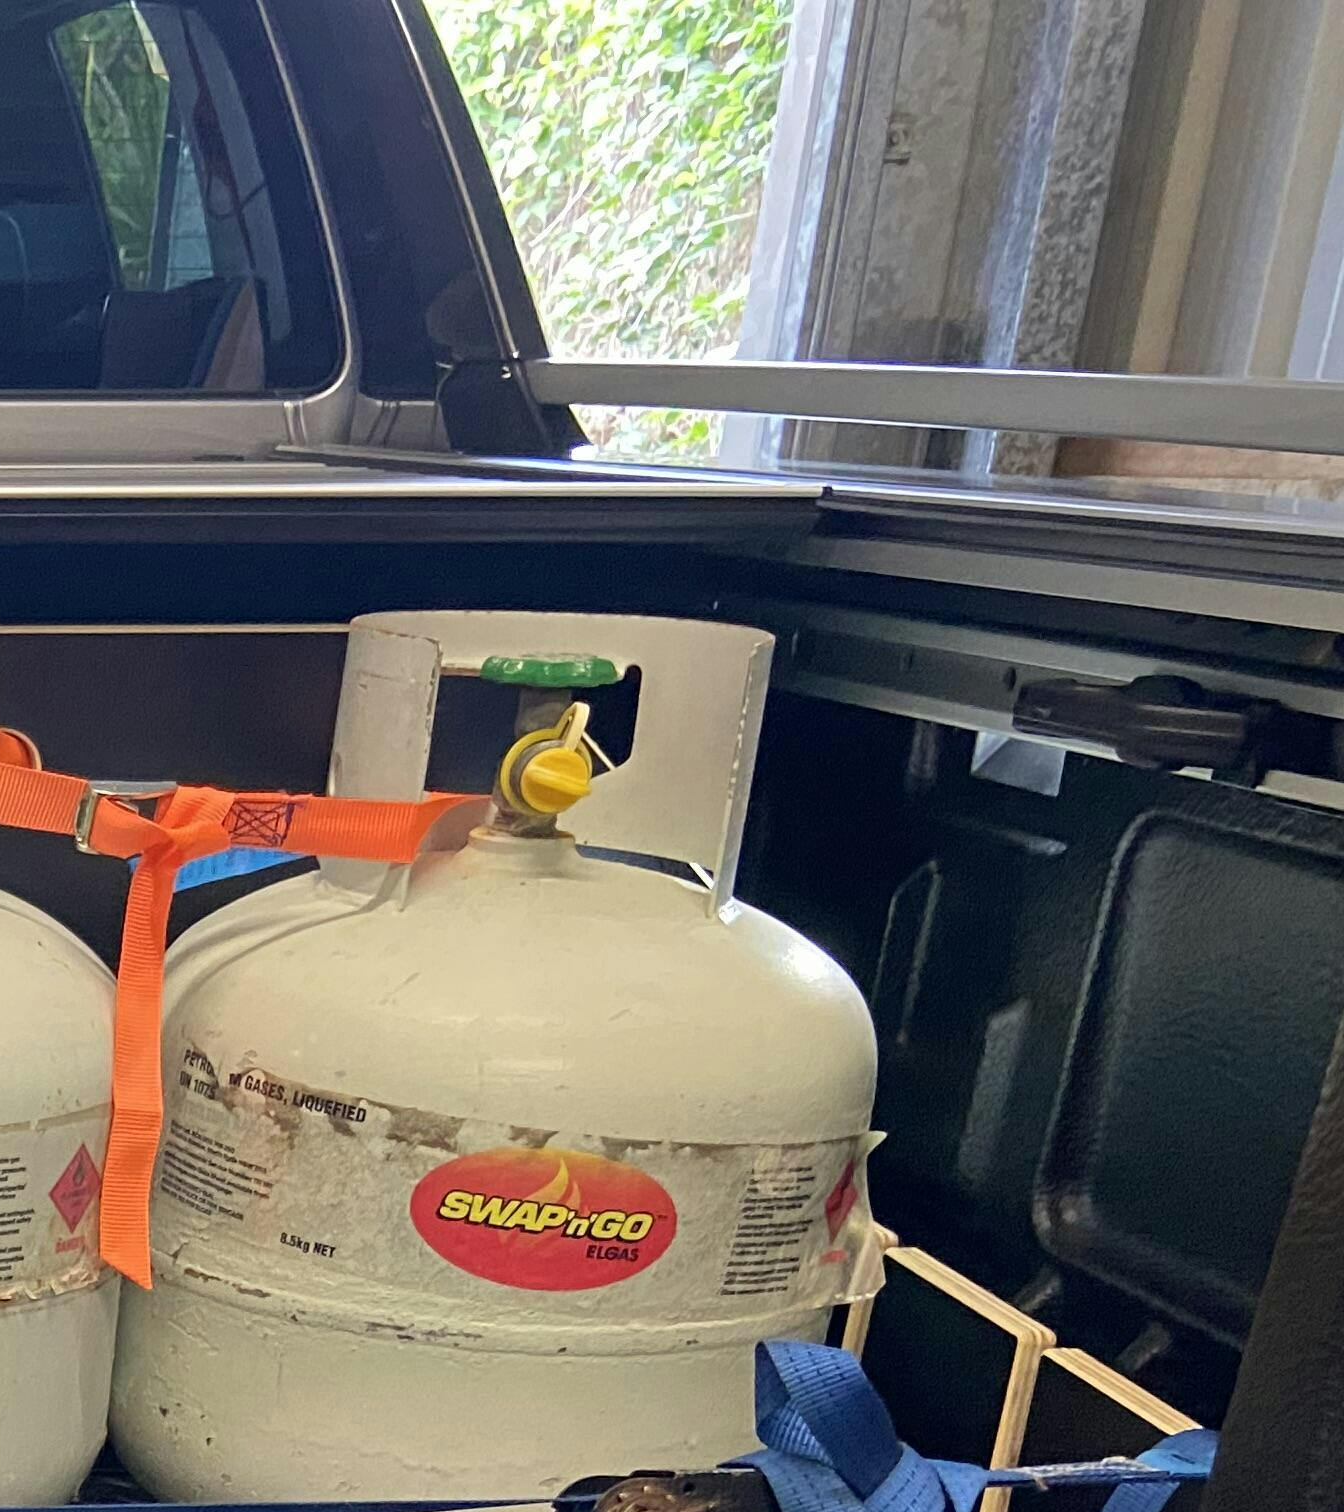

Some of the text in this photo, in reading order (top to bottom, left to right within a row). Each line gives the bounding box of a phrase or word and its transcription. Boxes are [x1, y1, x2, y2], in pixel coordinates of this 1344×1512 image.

[245, 1075, 287, 1105] GASES,
[292, 1090, 367, 1123] LIQUEFIED
[280, 1232, 336, 1258] 8.5kg NET
[586, 1245, 640, 1262] ELGAS
